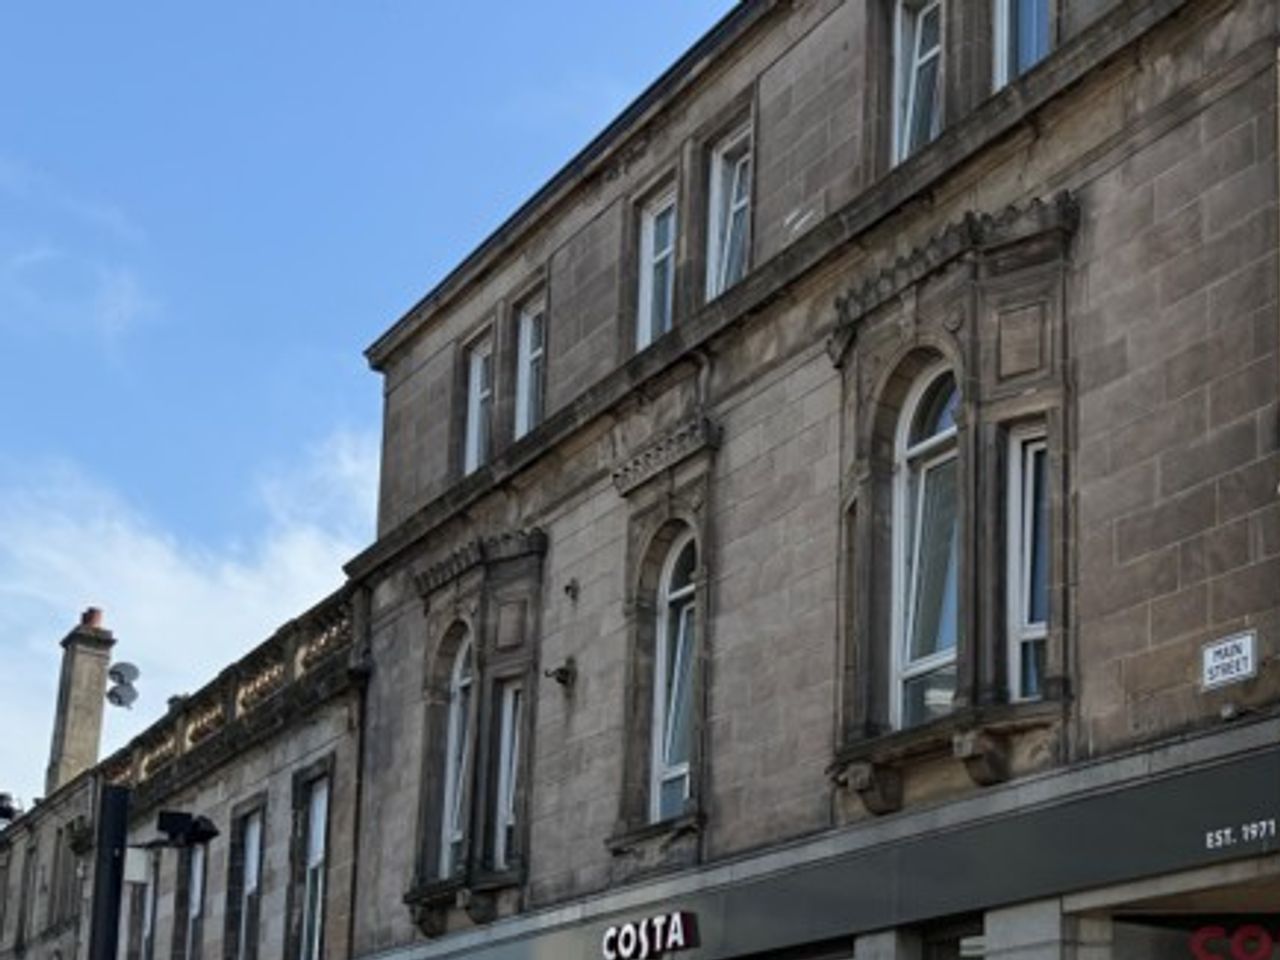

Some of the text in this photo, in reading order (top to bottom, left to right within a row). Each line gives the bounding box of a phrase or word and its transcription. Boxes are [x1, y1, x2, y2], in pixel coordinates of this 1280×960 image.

[1212, 642, 1243, 663] MAIN
[1207, 656, 1249, 681] STREET
[1206, 818, 1276, 849] EST. 1971
[602, 911, 684, 960] COSTA
